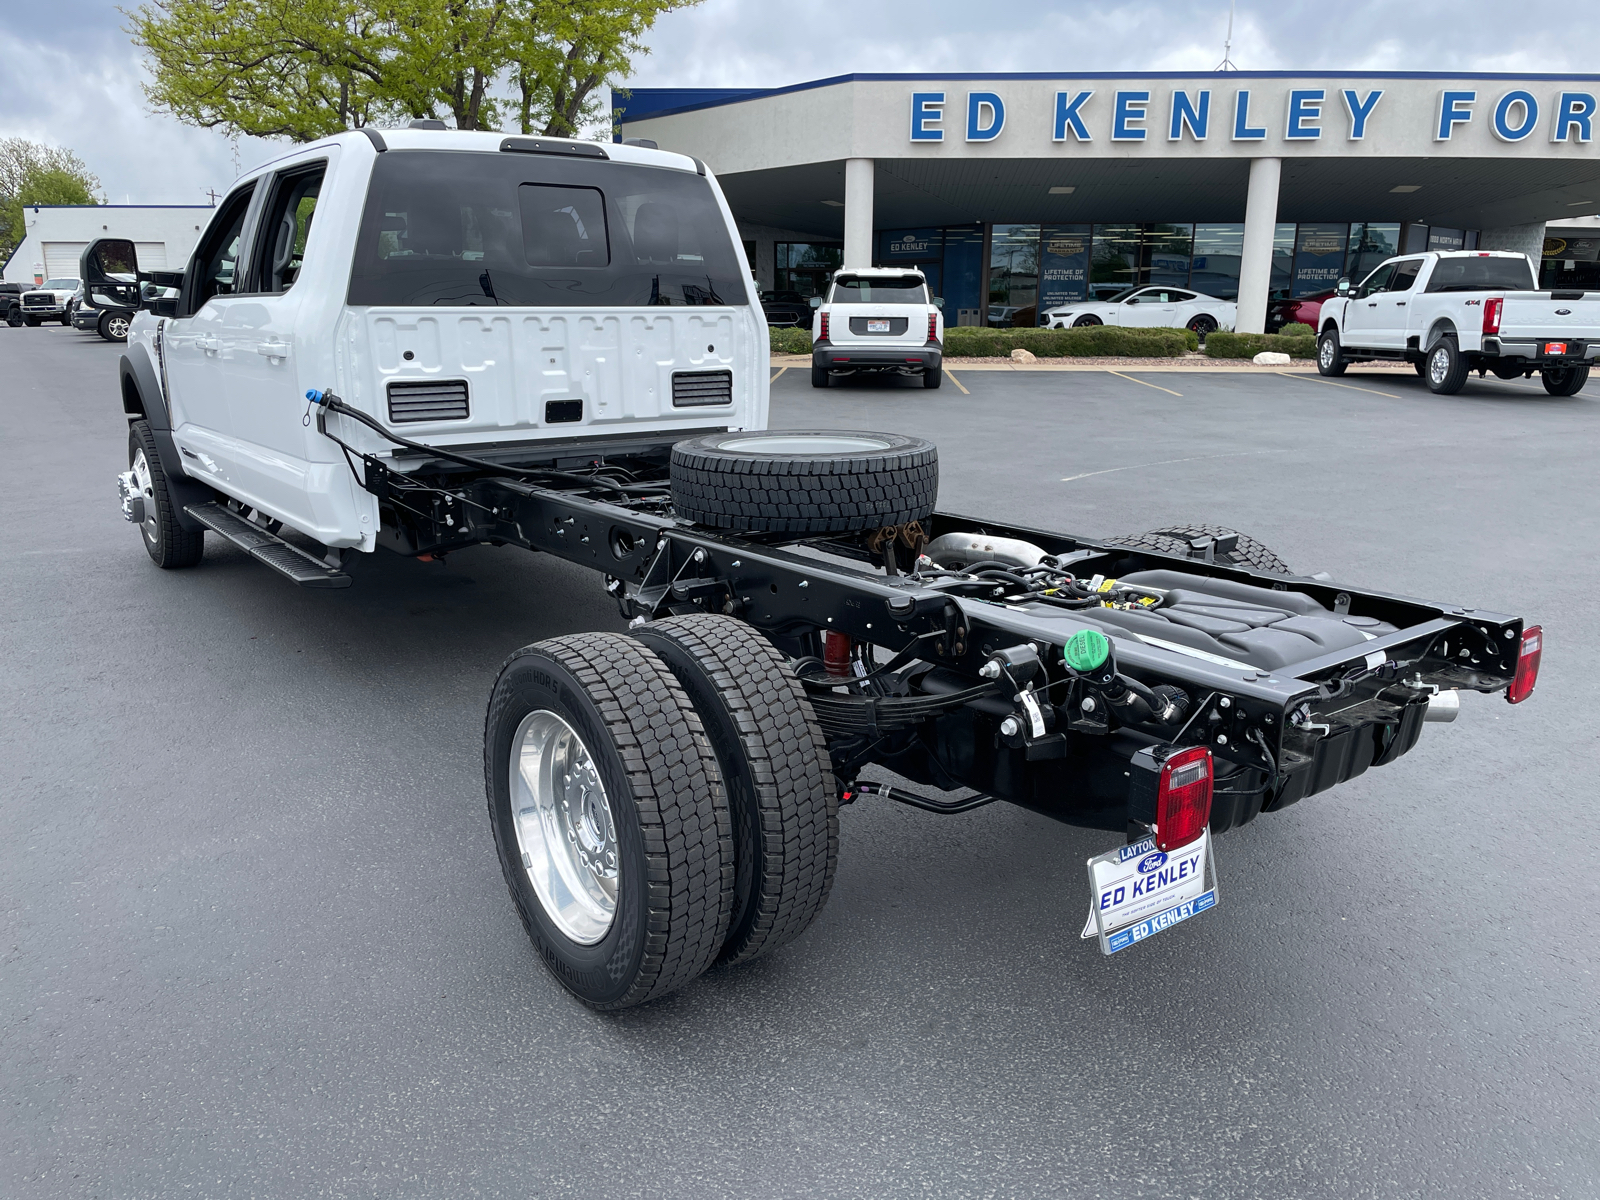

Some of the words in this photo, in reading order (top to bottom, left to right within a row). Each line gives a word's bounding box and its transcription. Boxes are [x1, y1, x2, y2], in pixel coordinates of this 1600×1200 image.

[909, 91, 1006, 143] ED
[1052, 89, 1385, 142] KENLEY
[1433, 90, 1598, 143] FOR
[891, 243, 900, 251] ED
[901, 242, 928, 250] KENLEY
[1439, 236, 1453, 244] NORTH
[1079, 635, 1087, 655] DIESEL
[533, 670, 551, 689] HDR
[552, 679, 559, 694] 5
[1120, 839, 1155, 860] LAYTON
[1139, 853, 1166, 873] Ford
[1100, 886, 1126, 911] ED
[1132, 855, 1200, 899] KENLEY
[1132, 924, 1149, 942] ED
[1151, 901, 1195, 932] KENLEY
